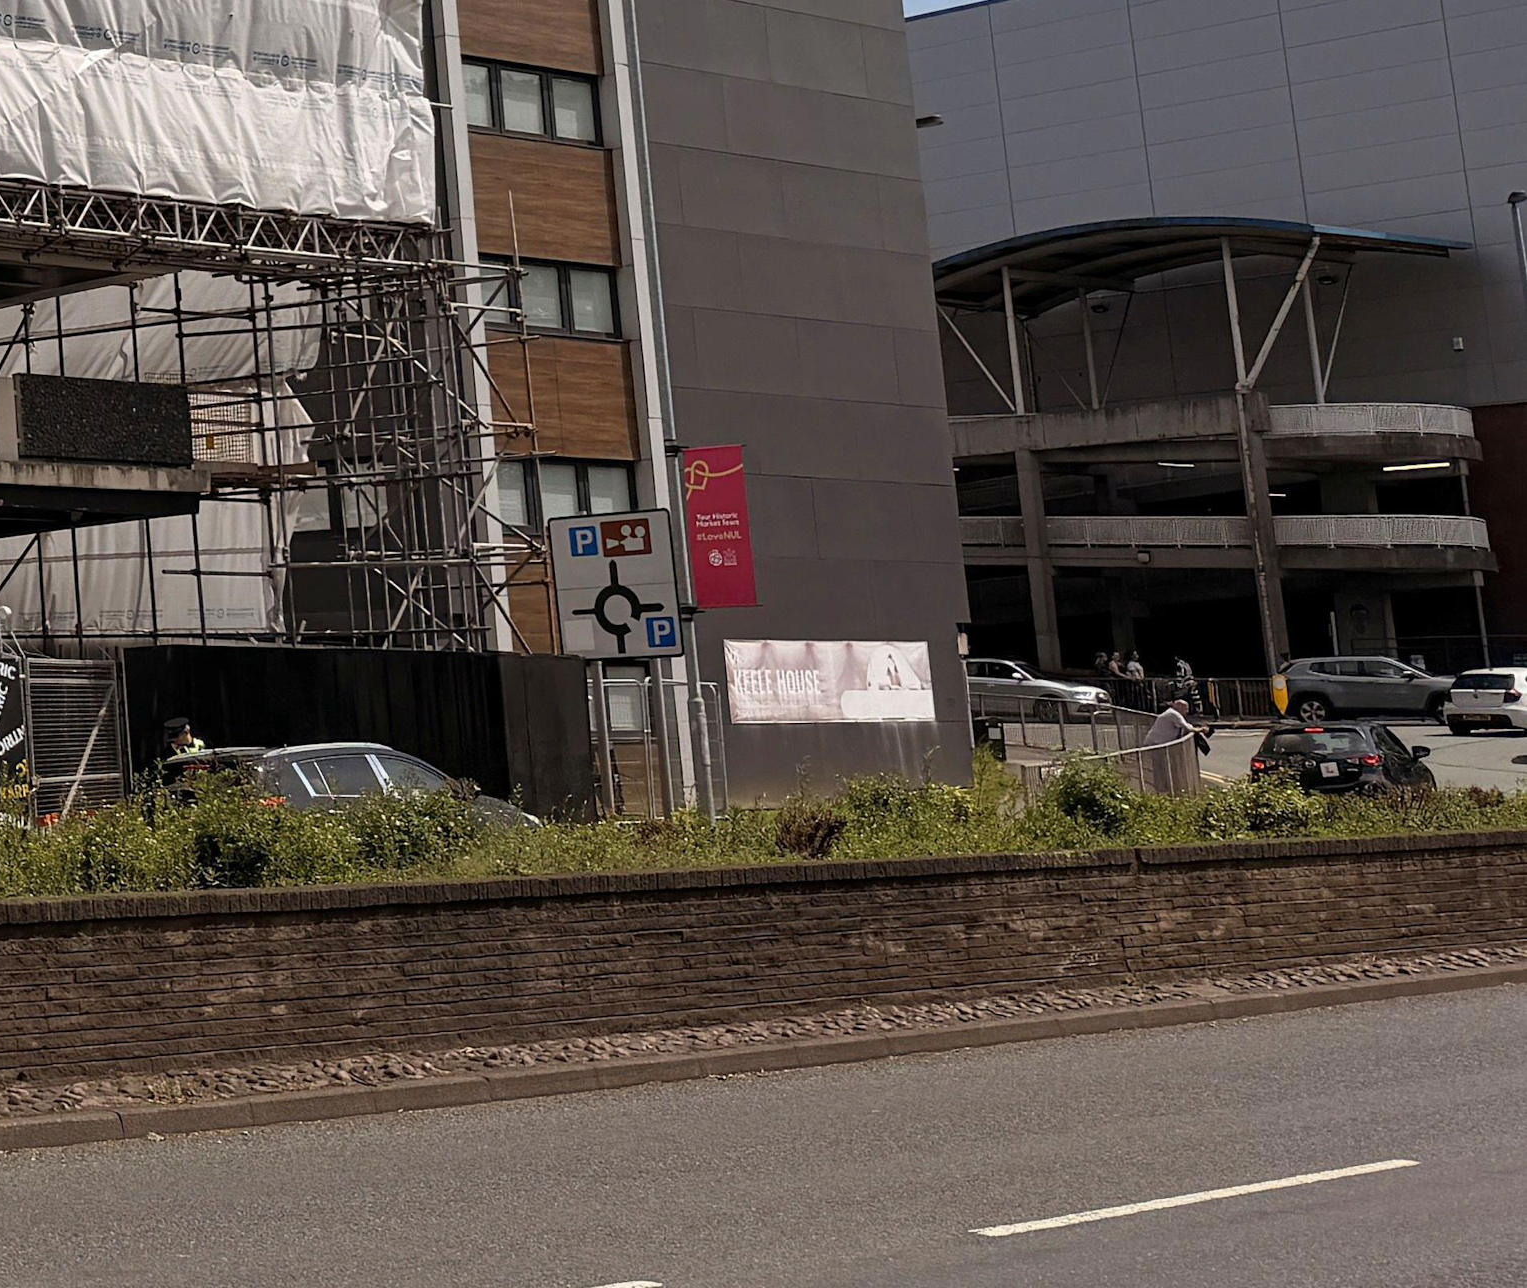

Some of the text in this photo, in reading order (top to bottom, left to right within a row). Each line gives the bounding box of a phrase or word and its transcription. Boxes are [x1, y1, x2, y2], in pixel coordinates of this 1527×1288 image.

[577, 530, 593, 555] P
[653, 620, 670, 644] P
[733, 669, 821, 695] KEELE HOUSE
